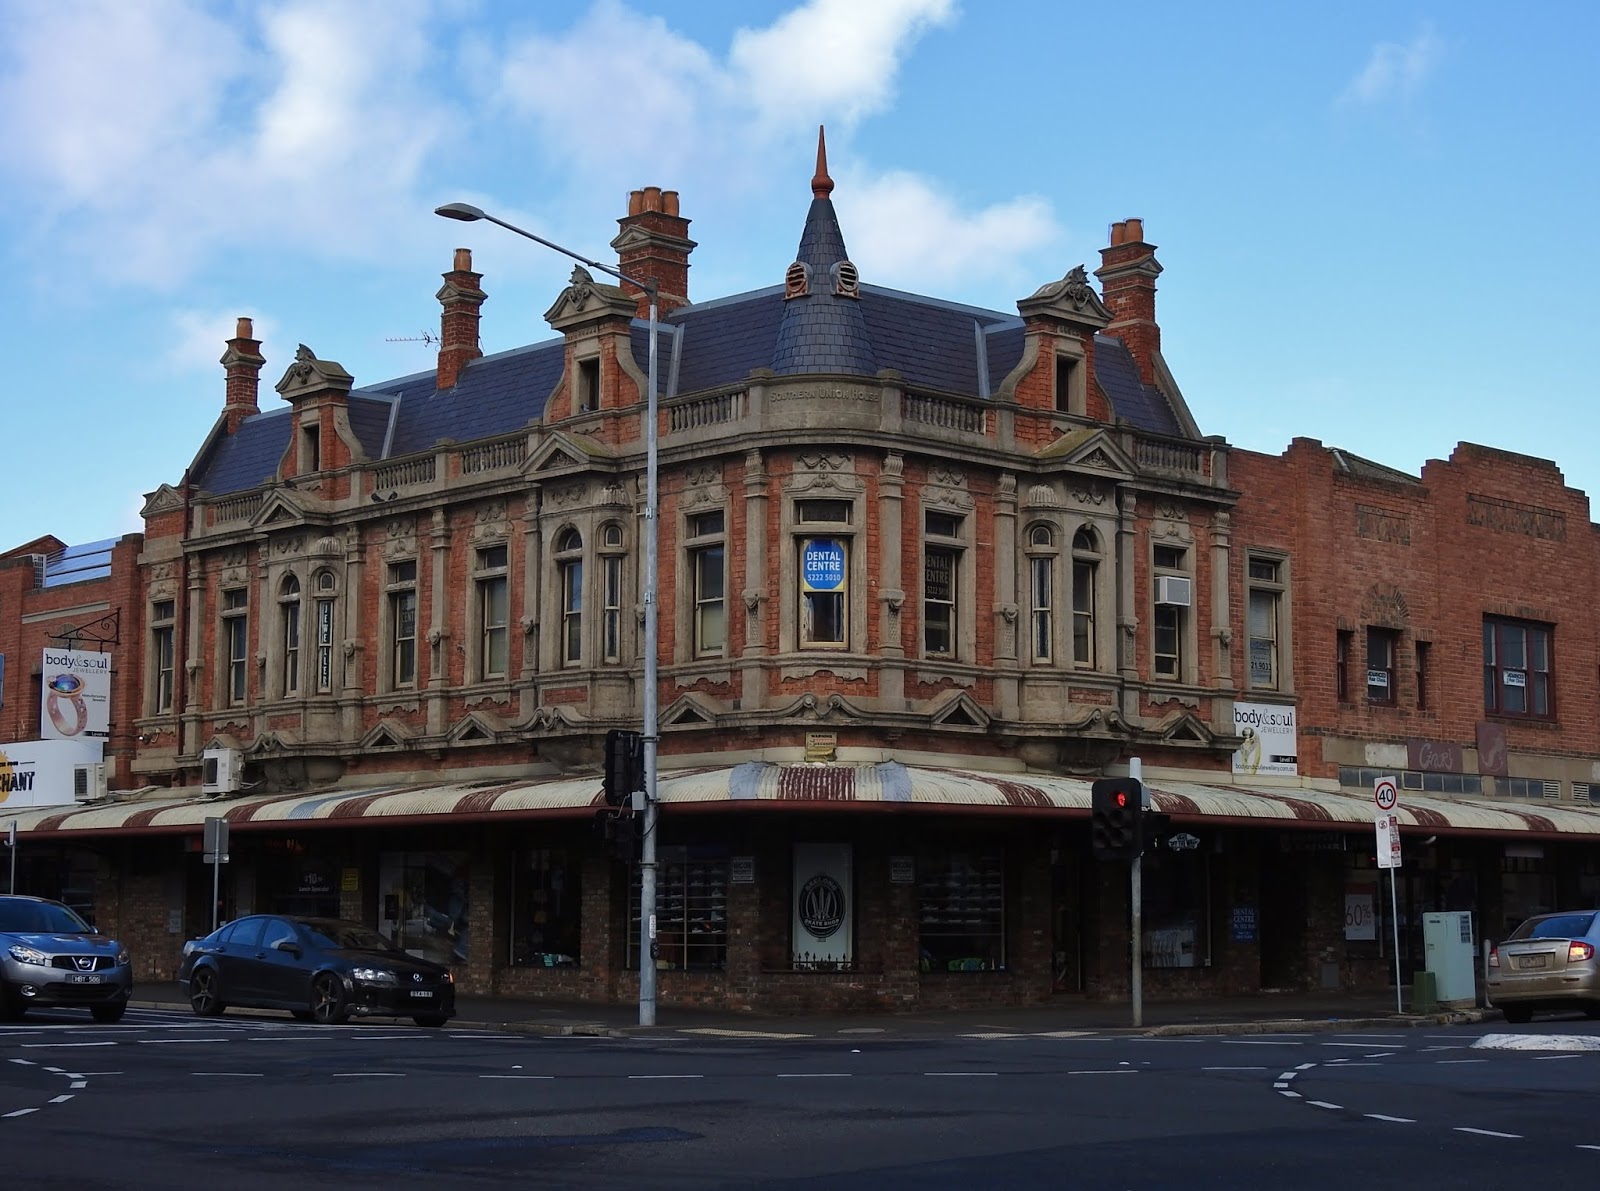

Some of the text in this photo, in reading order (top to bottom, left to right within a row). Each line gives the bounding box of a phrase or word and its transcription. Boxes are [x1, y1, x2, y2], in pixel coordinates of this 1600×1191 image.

[770, 387, 879, 402] SOUTHERN UNION HOUSE
[807, 552, 840, 560] DENTAL
[926, 554, 949, 569] ENTAL
[807, 562, 840, 571] CENTRE
[808, 573, 840, 581] 5222 5010
[926, 569, 949, 584] ENTRE
[322, 604, 330, 687] JEWELLER
[46, 653, 107, 669] body&soul
[1234, 707, 1293, 727] body&soul
[1261, 726, 1293, 734] JEWELLERY
[1379, 789, 1394, 803] 40
